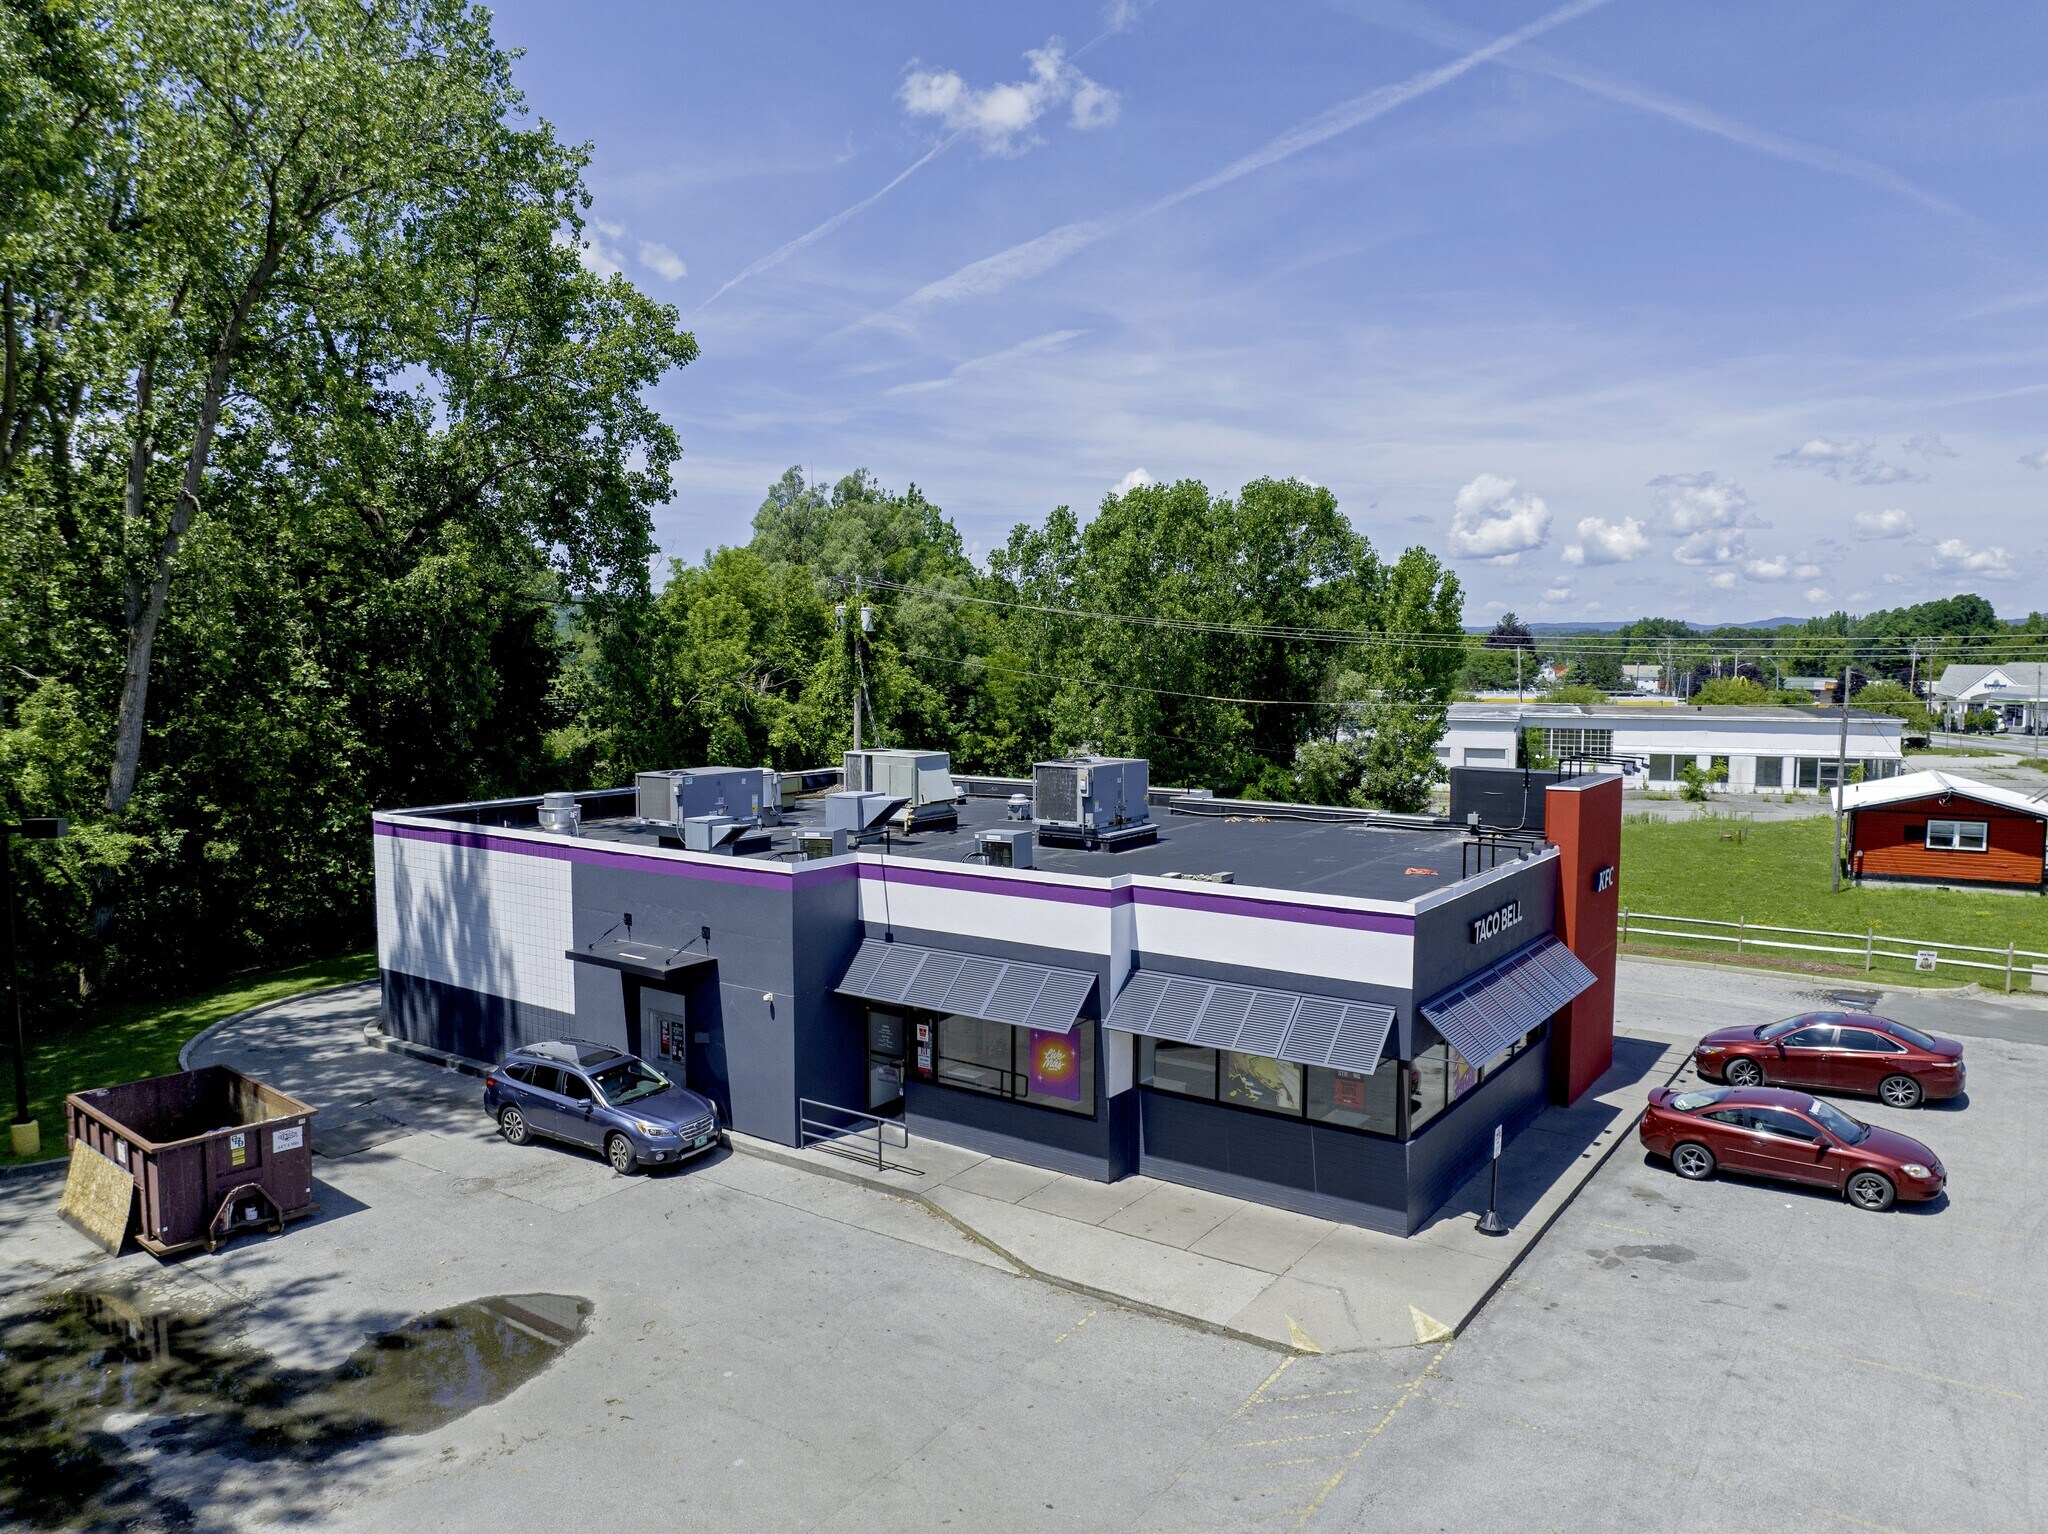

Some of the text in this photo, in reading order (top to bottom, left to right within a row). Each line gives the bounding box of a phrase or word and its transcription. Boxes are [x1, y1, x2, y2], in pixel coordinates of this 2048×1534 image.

[1598, 866, 1614, 892] KFC
[1474, 900, 1523, 944] TACO BELL
